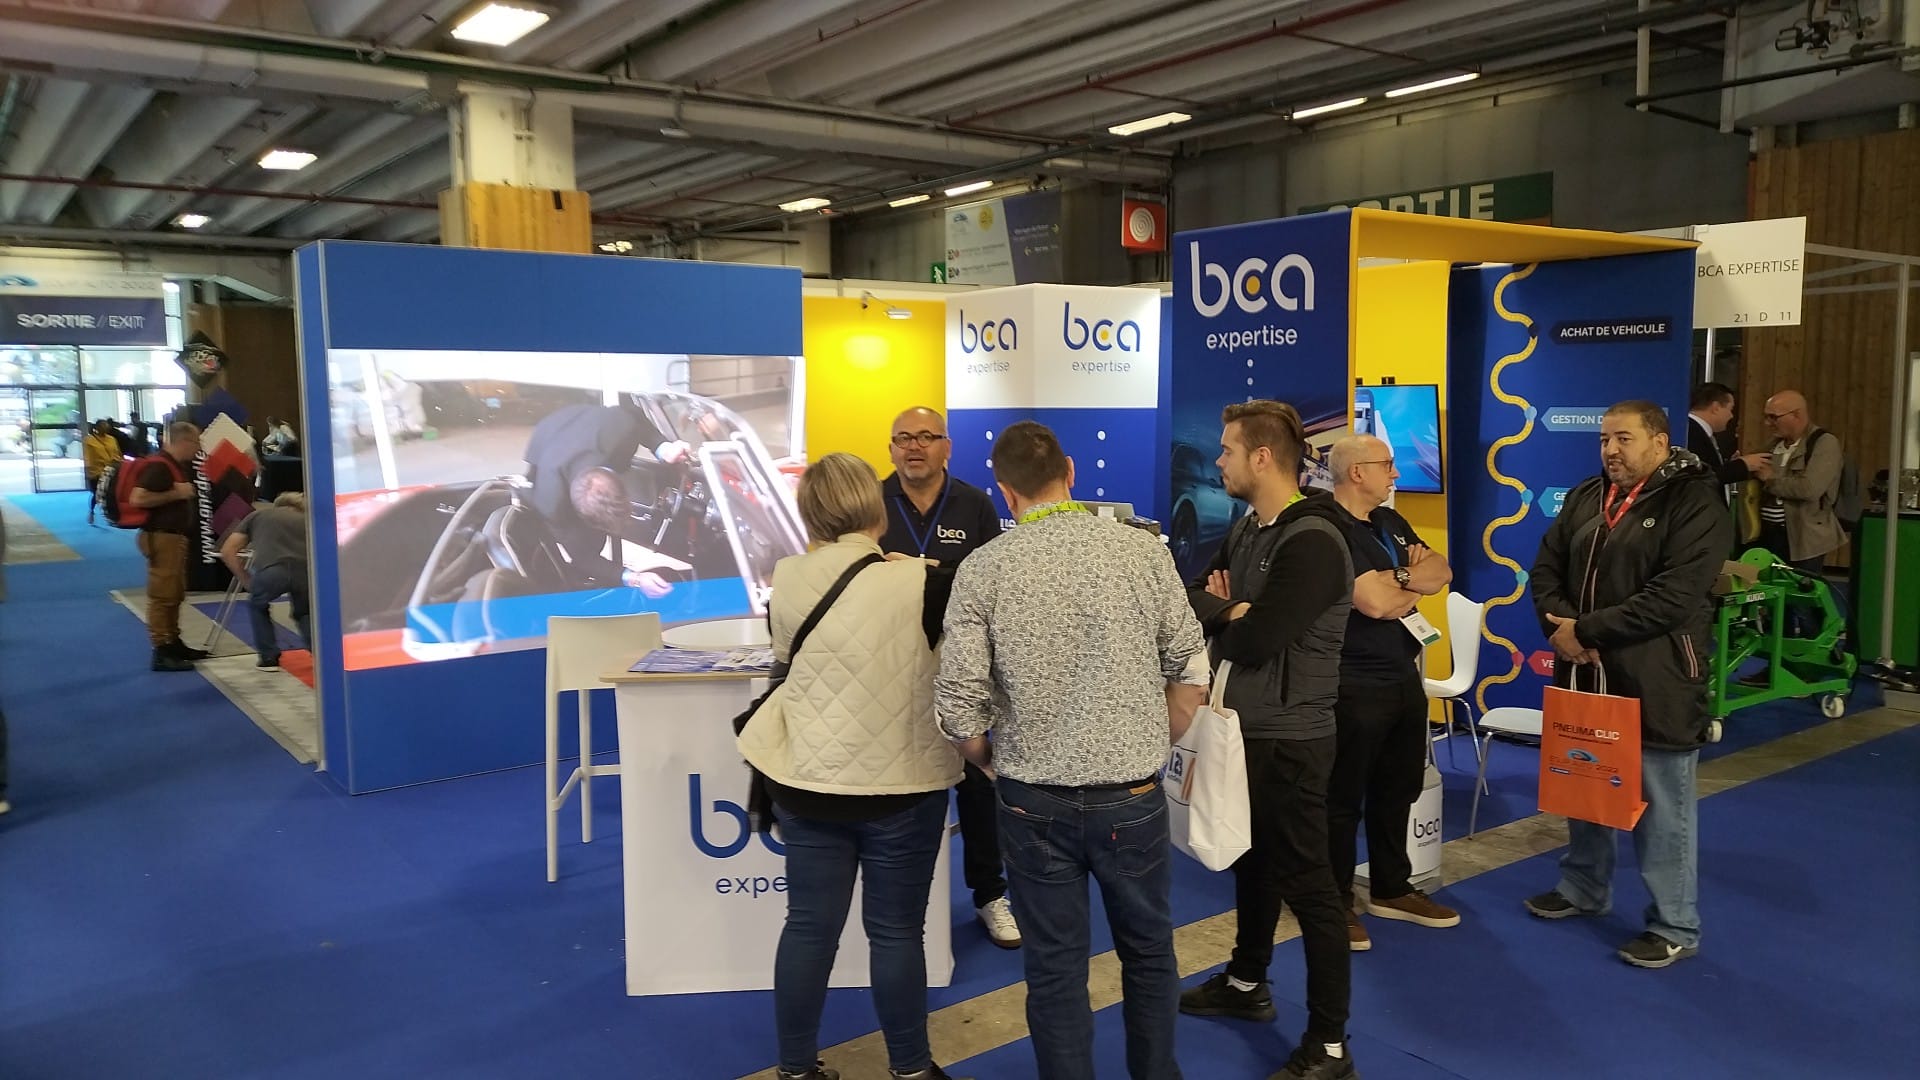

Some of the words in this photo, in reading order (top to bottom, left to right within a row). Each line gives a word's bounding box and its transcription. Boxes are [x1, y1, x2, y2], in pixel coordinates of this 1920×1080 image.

[1328, 184, 1494, 220] TIE
[1697, 265, 1724, 278] BCA
[1728, 259, 1800, 276] EXPERTISE
[1190, 241, 1314, 317] bca
[16, 313, 97, 329] SORTIE
[108, 315, 146, 329] EXIT
[1734, 313, 1749, 323] 2.1
[1759, 312, 1768, 322] D
[1780, 312, 1791, 321] 11
[960, 309, 1017, 353] bca
[1063, 301, 1141, 352] bca
[1560, 326, 1594, 338] ACHAT
[1596, 325, 1610, 336] DE
[1611, 323, 1666, 336] VEHICULE
[1206, 325, 1298, 352] expertise
[967, 360, 1010, 374] expertise
[1072, 359, 1131, 374] expertise
[1550, 414, 1596, 425] GESTION
[937, 524, 966, 540] bca
[1552, 721, 1620, 741] PNEUMACLIC
